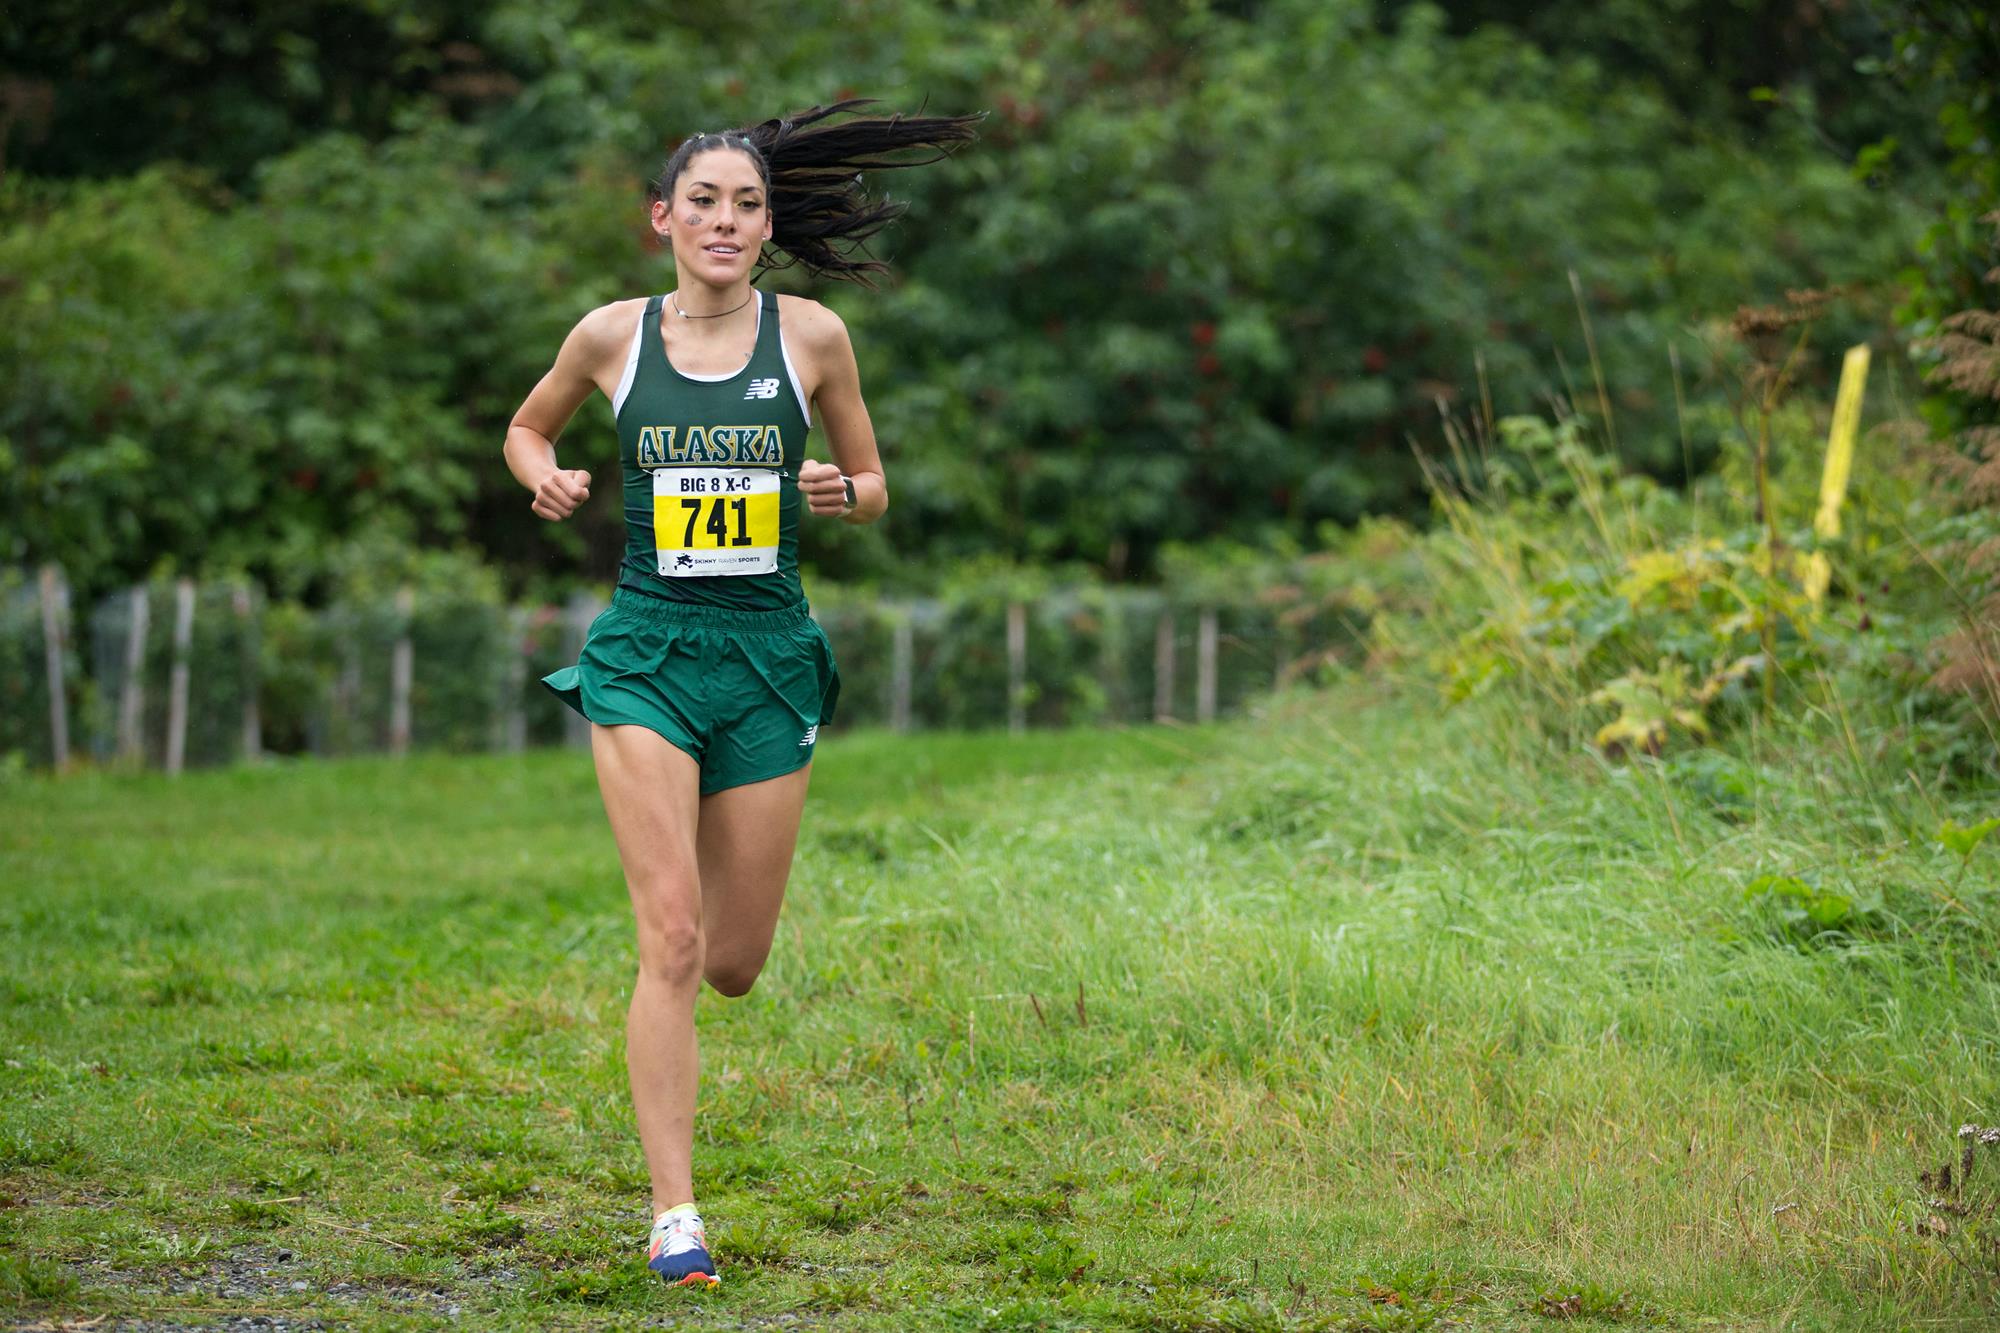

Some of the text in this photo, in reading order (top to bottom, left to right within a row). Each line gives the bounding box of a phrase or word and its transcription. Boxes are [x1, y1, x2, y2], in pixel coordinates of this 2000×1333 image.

[638, 425, 784, 468] ALASKA
[680, 476, 751, 493] BIG 8 X-C
[681, 497, 752, 548] 741
